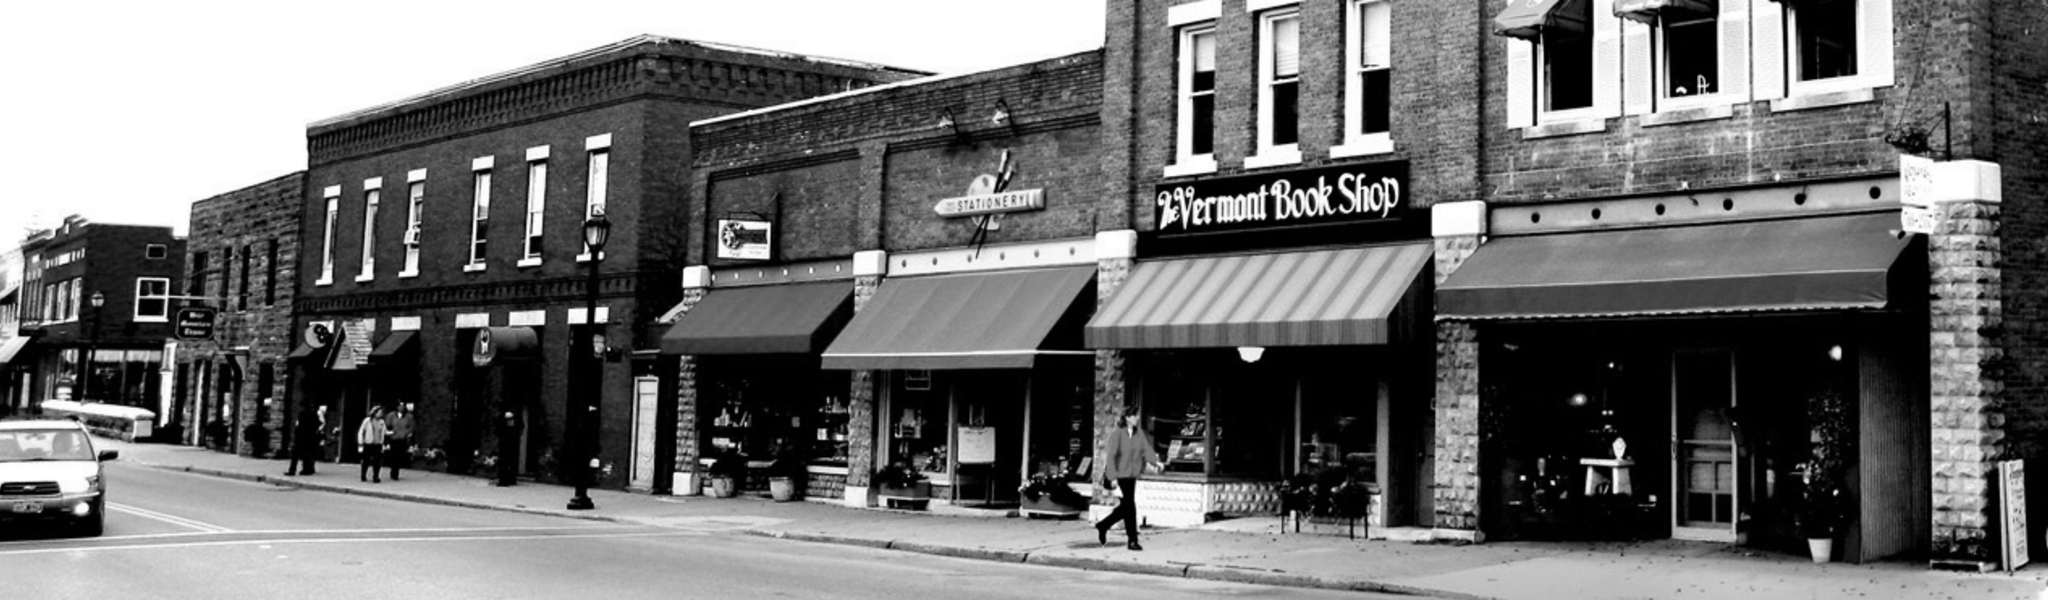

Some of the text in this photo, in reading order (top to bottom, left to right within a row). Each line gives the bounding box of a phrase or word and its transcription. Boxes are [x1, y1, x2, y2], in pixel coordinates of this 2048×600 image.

[957, 194, 1026, 212] STATIONERY
[1173, 184, 1269, 230] Vermont
[1270, 179, 1336, 220] Book
[1338, 173, 1399, 219] Shop
